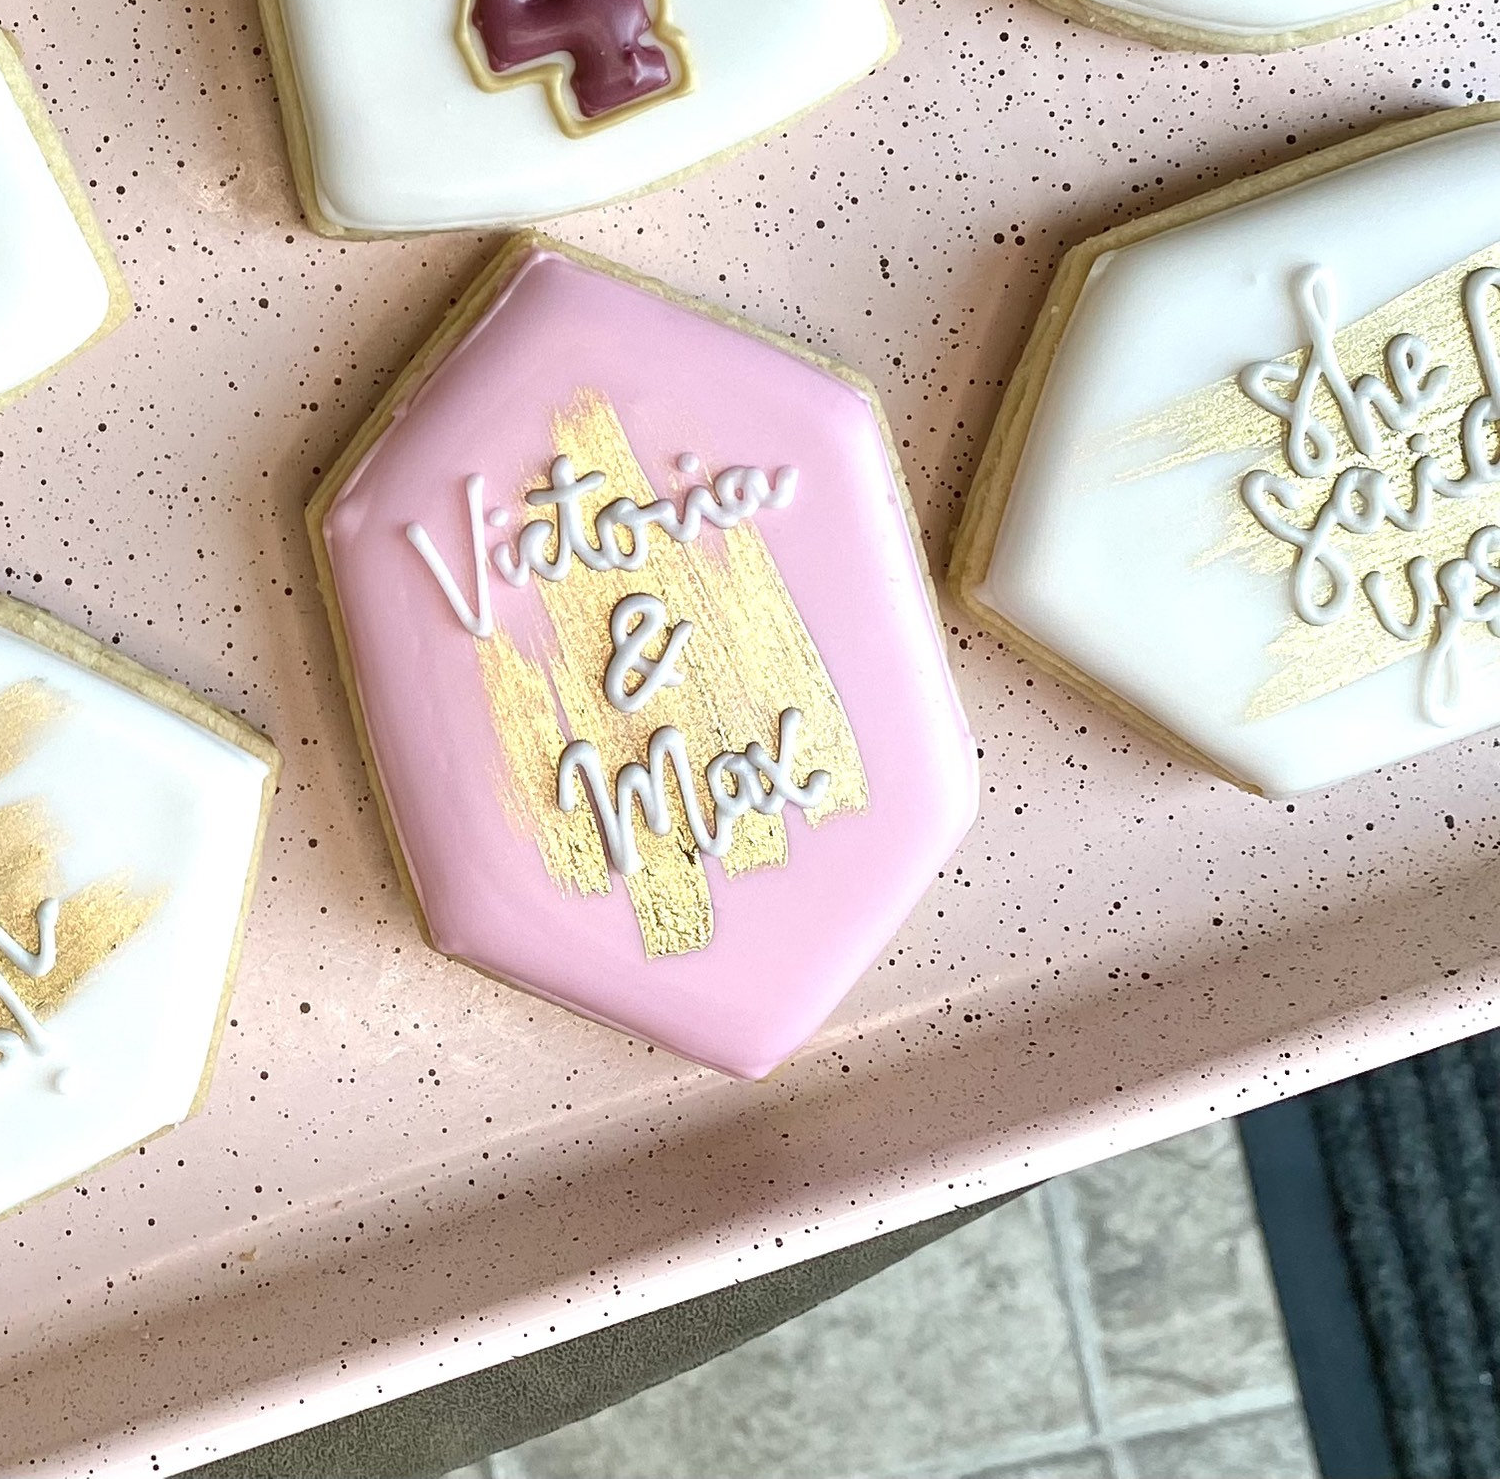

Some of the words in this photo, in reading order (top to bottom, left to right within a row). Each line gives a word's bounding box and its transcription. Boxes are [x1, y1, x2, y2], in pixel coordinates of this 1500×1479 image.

[1239, 262, 1451, 478] She
[406, 452, 800, 638] Victoria
[605, 592, 693, 713] &
[557, 706, 832, 875] Max
